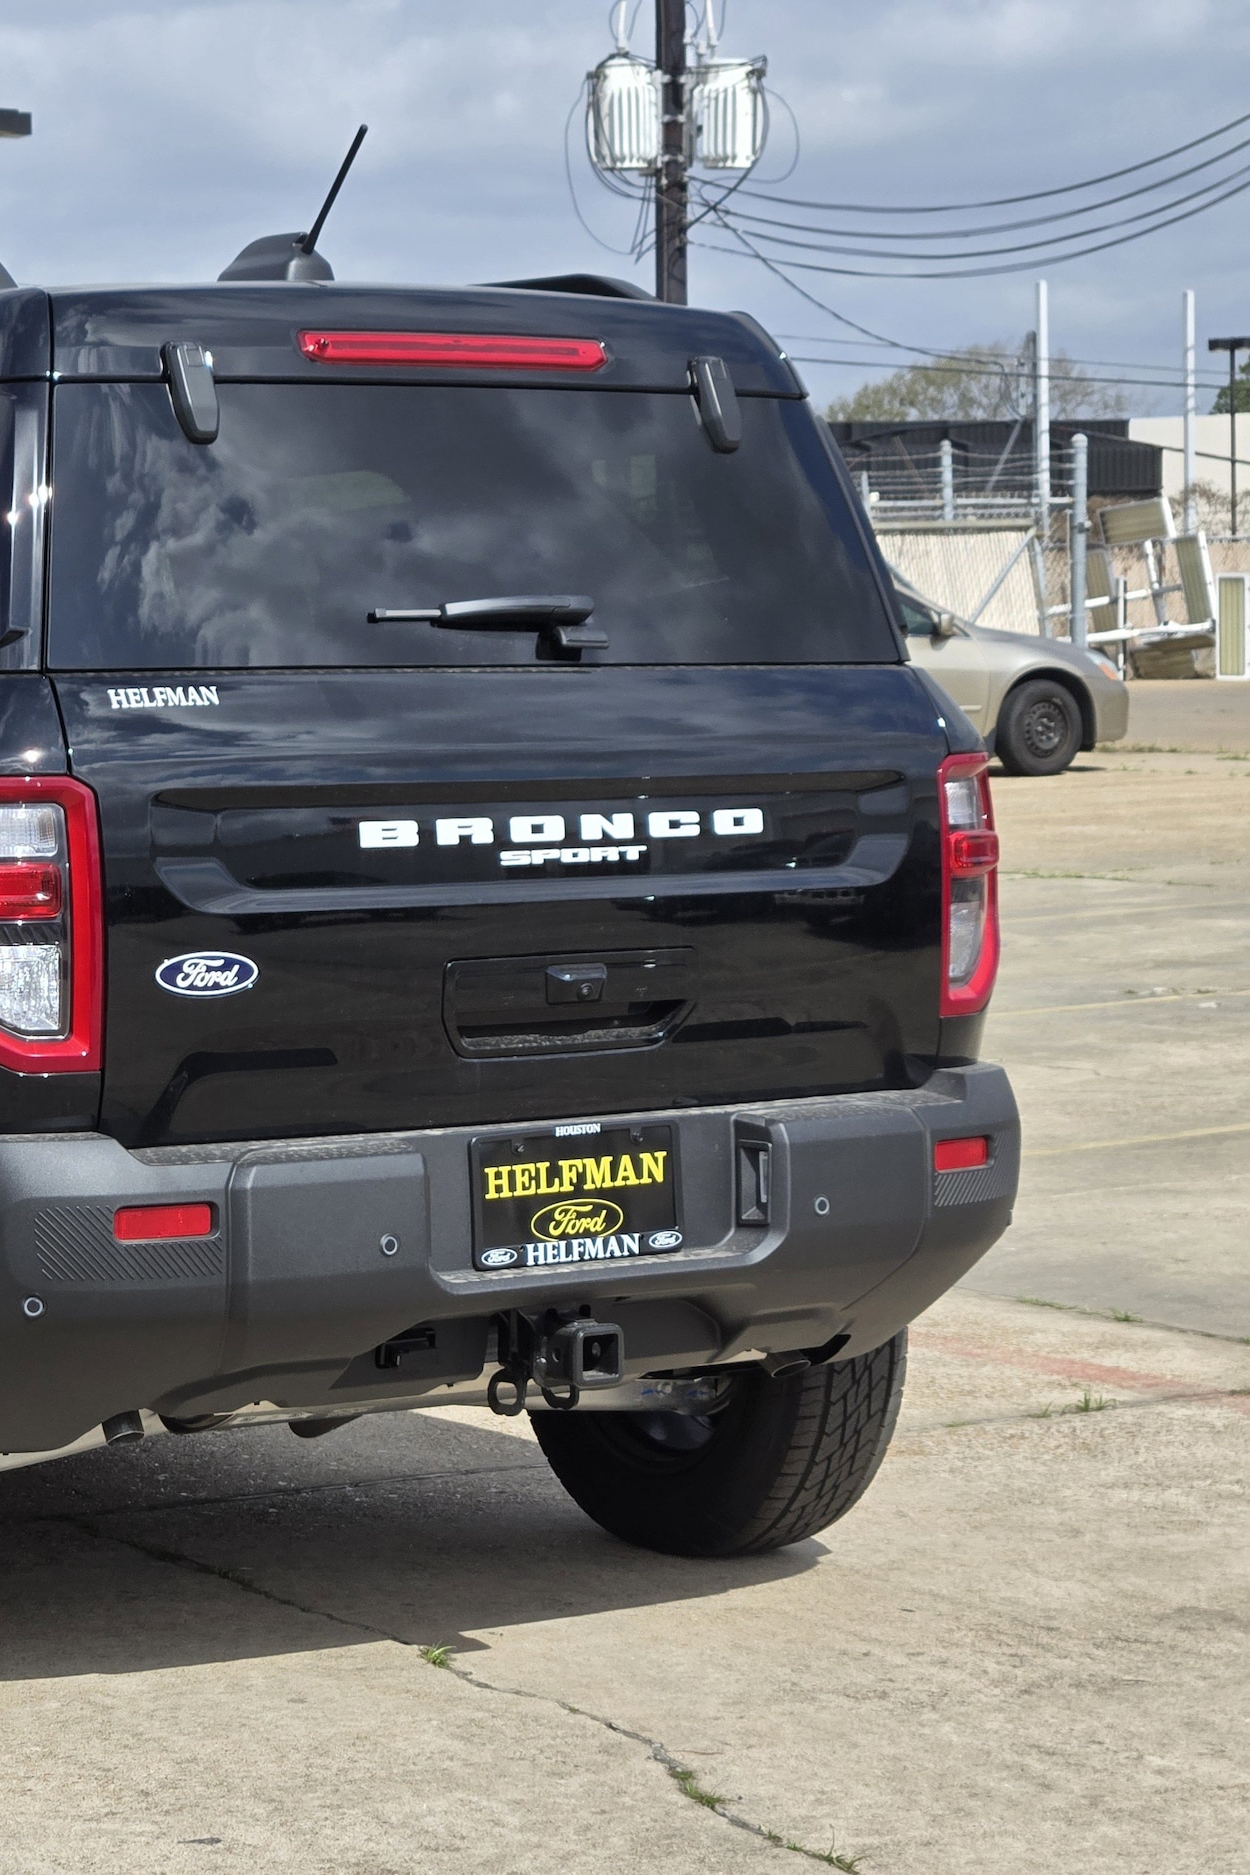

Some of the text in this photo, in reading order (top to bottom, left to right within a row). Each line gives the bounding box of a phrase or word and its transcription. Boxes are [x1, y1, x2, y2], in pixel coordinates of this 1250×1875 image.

[107, 686, 220, 709] HELFMAN
[358, 807, 764, 849] BRONCO
[499, 845, 648, 867] SPORT
[176, 958, 240, 988] Ford
[555, 1123, 601, 1137] HOUSTON
[484, 1151, 667, 1199] HELFMAN
[549, 1204, 608, 1236] Ford
[487, 1233, 677, 1266] Ford HELFMAN Ford
